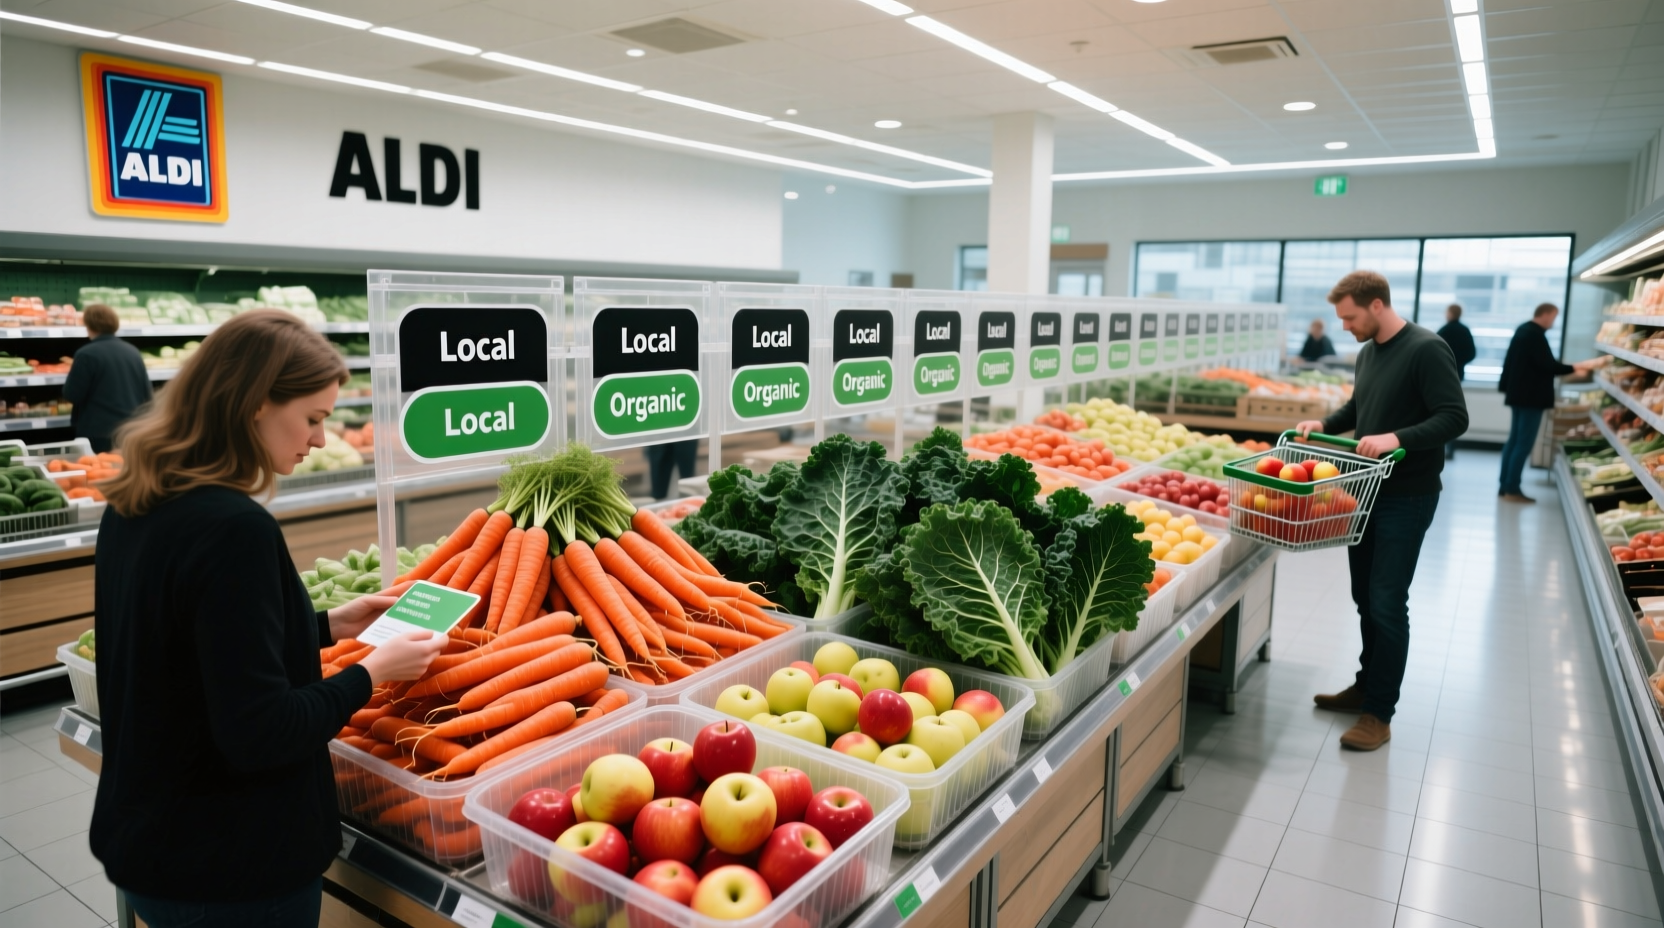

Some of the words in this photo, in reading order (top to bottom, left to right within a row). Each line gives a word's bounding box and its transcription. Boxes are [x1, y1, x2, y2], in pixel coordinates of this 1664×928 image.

[121, 152, 203, 187] ALDI
[329, 131, 481, 211] ALDI
[440, 329, 515, 363] Local
[621, 325, 676, 354] Local
[752, 323, 792, 348] Local
[849, 322, 880, 344] Local
[926, 321, 951, 341] Local
[743, 377, 800, 408] Organic
[842, 370, 886, 397] Organic
[444, 401, 515, 437] Local
[609, 386, 686, 422] Organic
